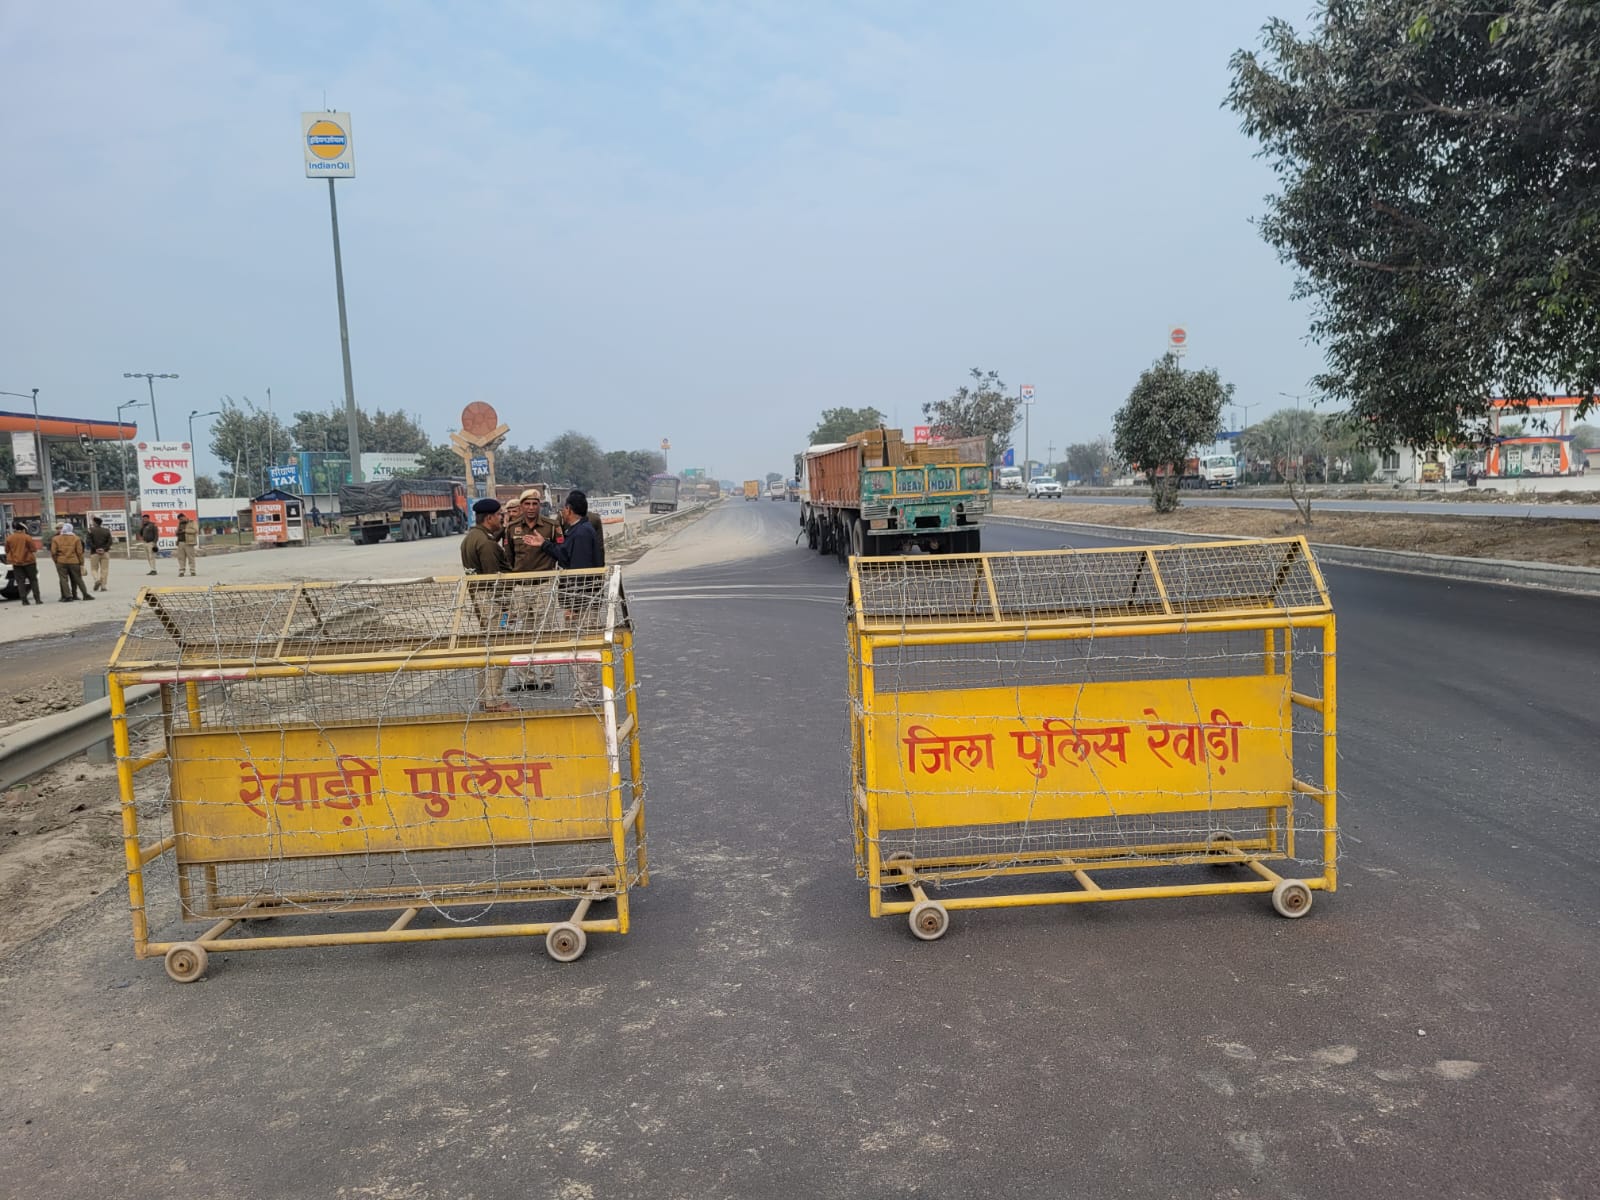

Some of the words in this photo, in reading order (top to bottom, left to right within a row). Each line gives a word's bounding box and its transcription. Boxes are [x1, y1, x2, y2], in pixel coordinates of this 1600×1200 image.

[308, 161, 350, 170] IndianOil
[143, 455, 188, 470] हरियाणा
[471, 466, 489, 476] TAX
[271, 475, 297, 486] TAX
[902, 725, 996, 775] जिला
[1009, 717, 1131, 779] पुलिस
[1143, 708, 1244, 776] रेवाड़ी
[239, 754, 379, 826] रेवाड़ी
[403, 748, 553, 818] पुलिस
